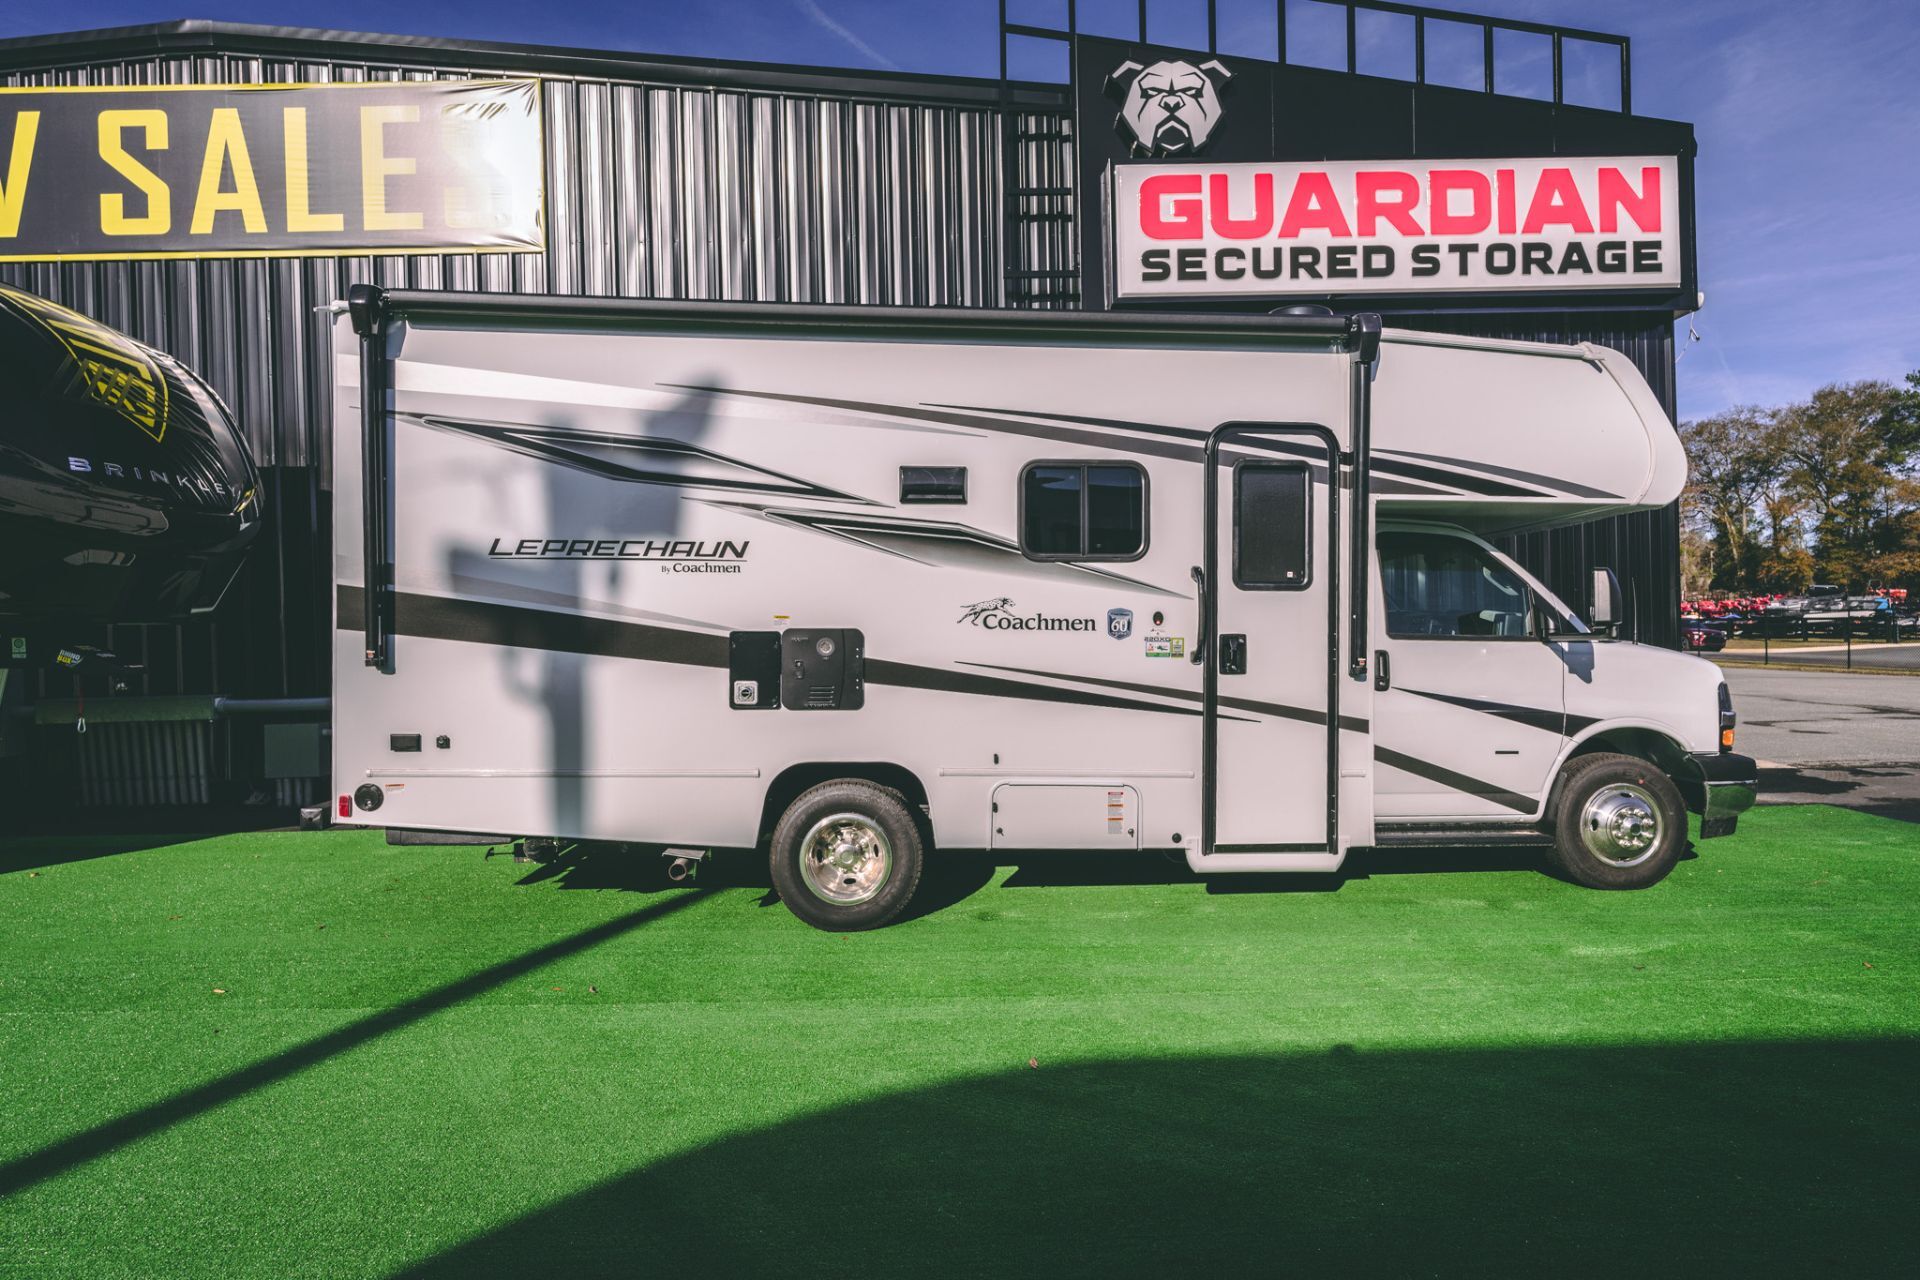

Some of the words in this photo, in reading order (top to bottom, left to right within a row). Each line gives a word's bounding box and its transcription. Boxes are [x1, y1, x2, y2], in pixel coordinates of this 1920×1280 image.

[1138, 166, 1662, 240] GUARDIAN
[1141, 244, 1395, 282] SECURED
[1411, 240, 1663, 277] STORAGE
[488, 538, 750, 559] LEPRECHAUN
[661, 565, 671, 574] By
[672, 562, 741, 574] Coachmen
[982, 612, 1097, 632] Coachmen
[1111, 619, 1128, 632] 60
